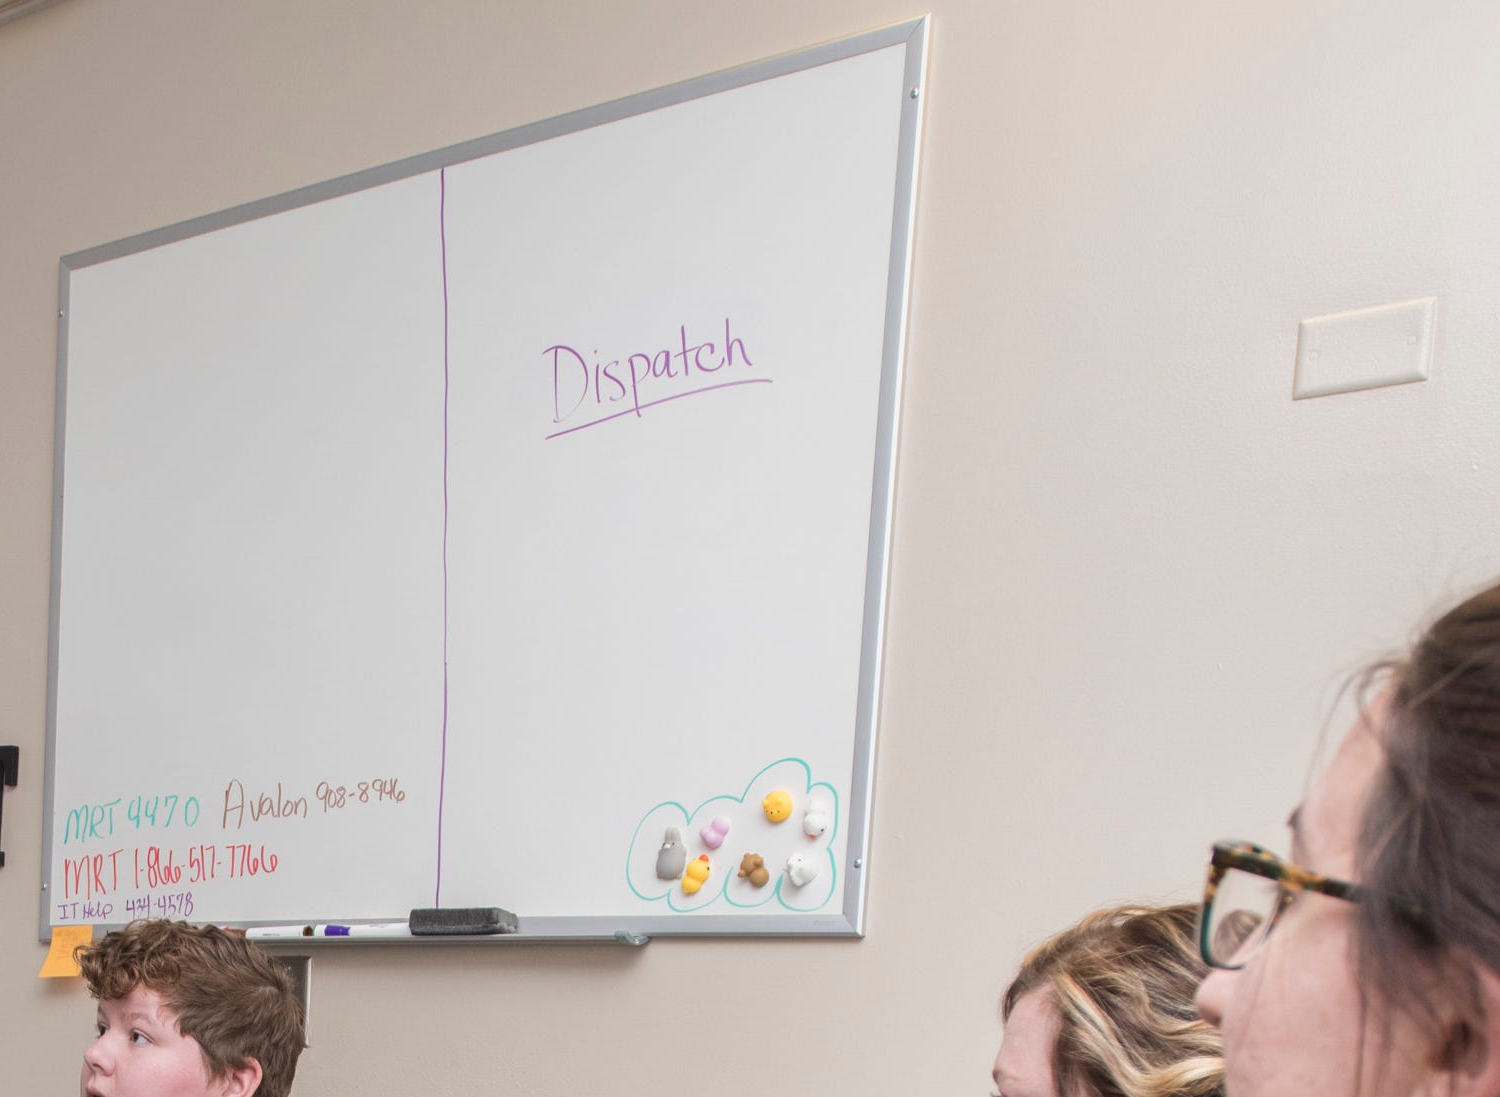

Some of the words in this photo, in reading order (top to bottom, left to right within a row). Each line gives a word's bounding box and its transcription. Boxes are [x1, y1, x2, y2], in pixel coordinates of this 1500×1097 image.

[541, 317, 753, 424] Dispatch
[63, 797, 122, 845] MRT
[127, 794, 200, 829] 4470
[222, 778, 308, 829] Avalon
[315, 777, 406, 813] 908-8946
[64, 848, 124, 900] MRT
[134, 844, 279, 889] 1-866-517-7766
[57, 902, 79, 920] IT
[82, 900, 114, 921] Help
